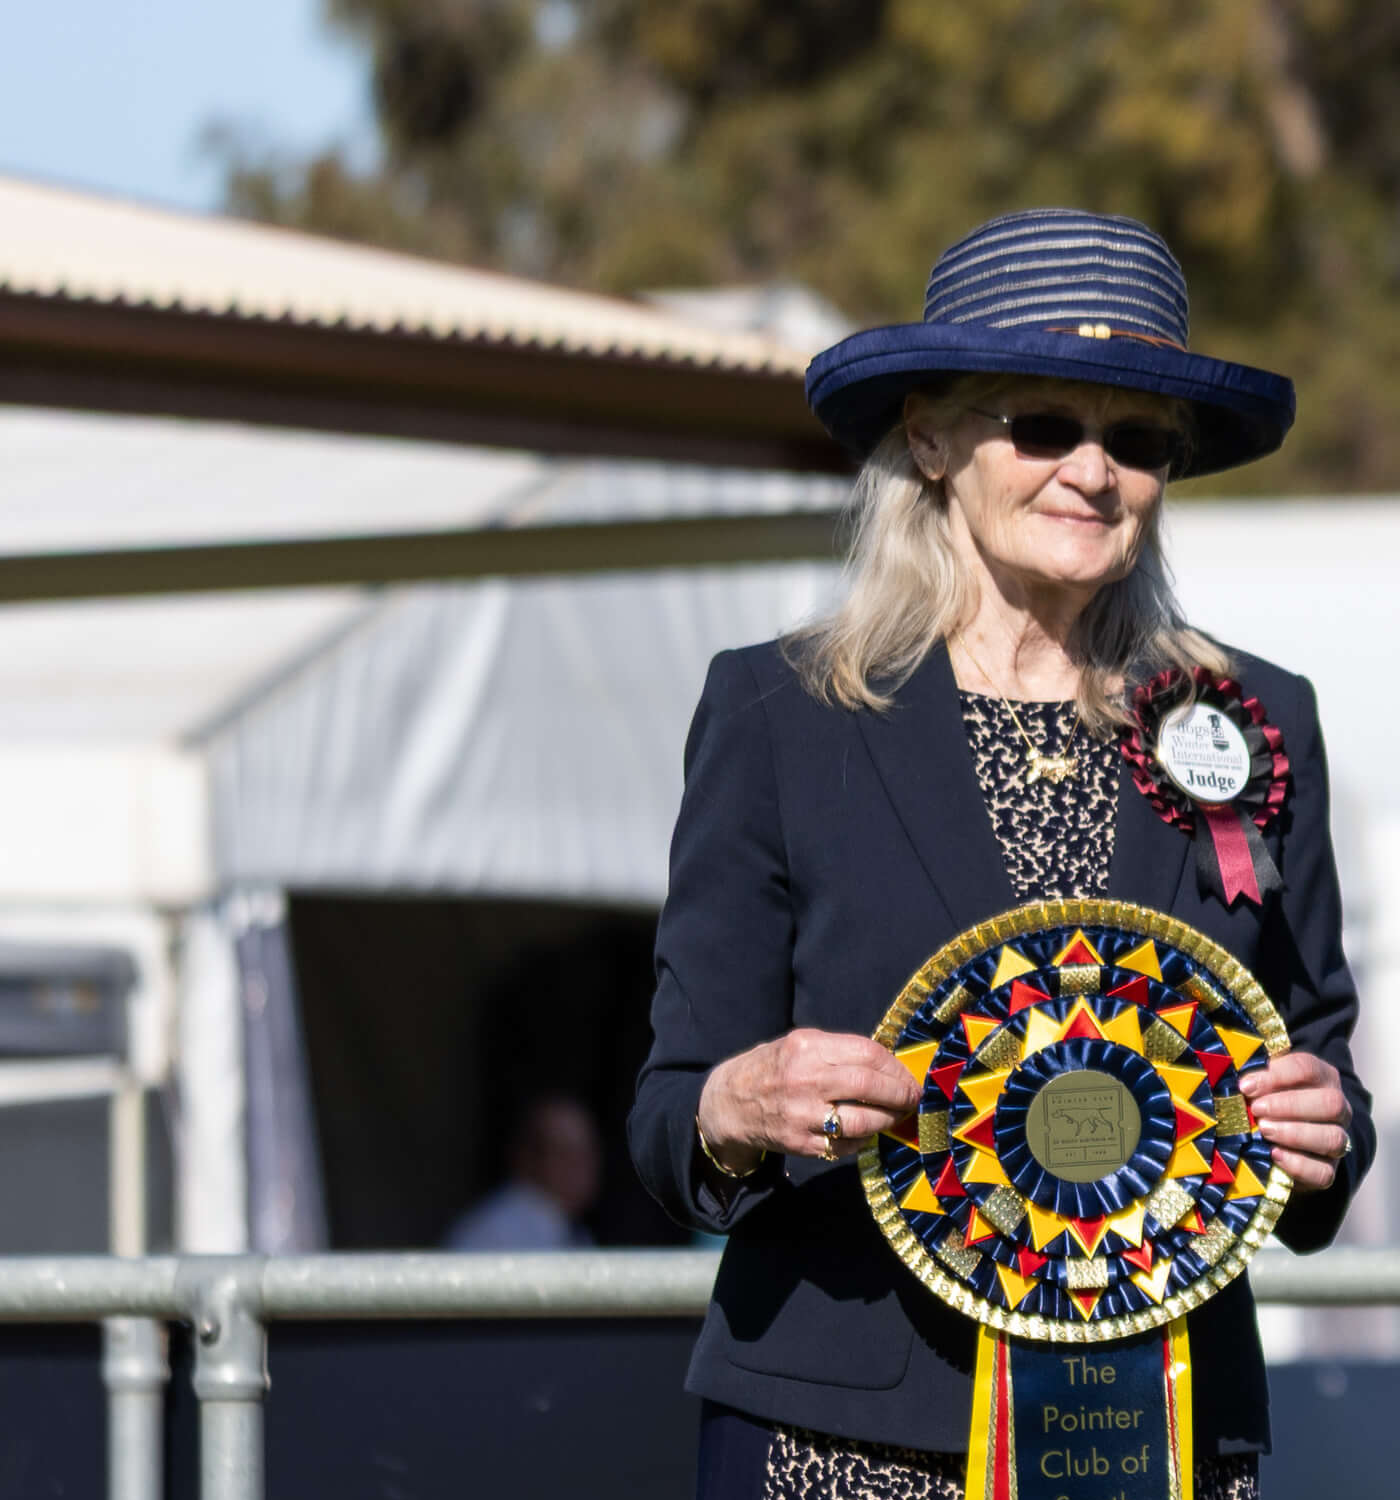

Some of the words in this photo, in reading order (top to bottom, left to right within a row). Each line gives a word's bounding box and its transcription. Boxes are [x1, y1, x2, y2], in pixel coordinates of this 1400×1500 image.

[1186, 768, 1237, 793] Judge
[1062, 1356, 1117, 1385] The
[1043, 1405, 1144, 1433] Pointer
[1040, 1447, 1110, 1479] Club
[1120, 1444, 1150, 1474] of
